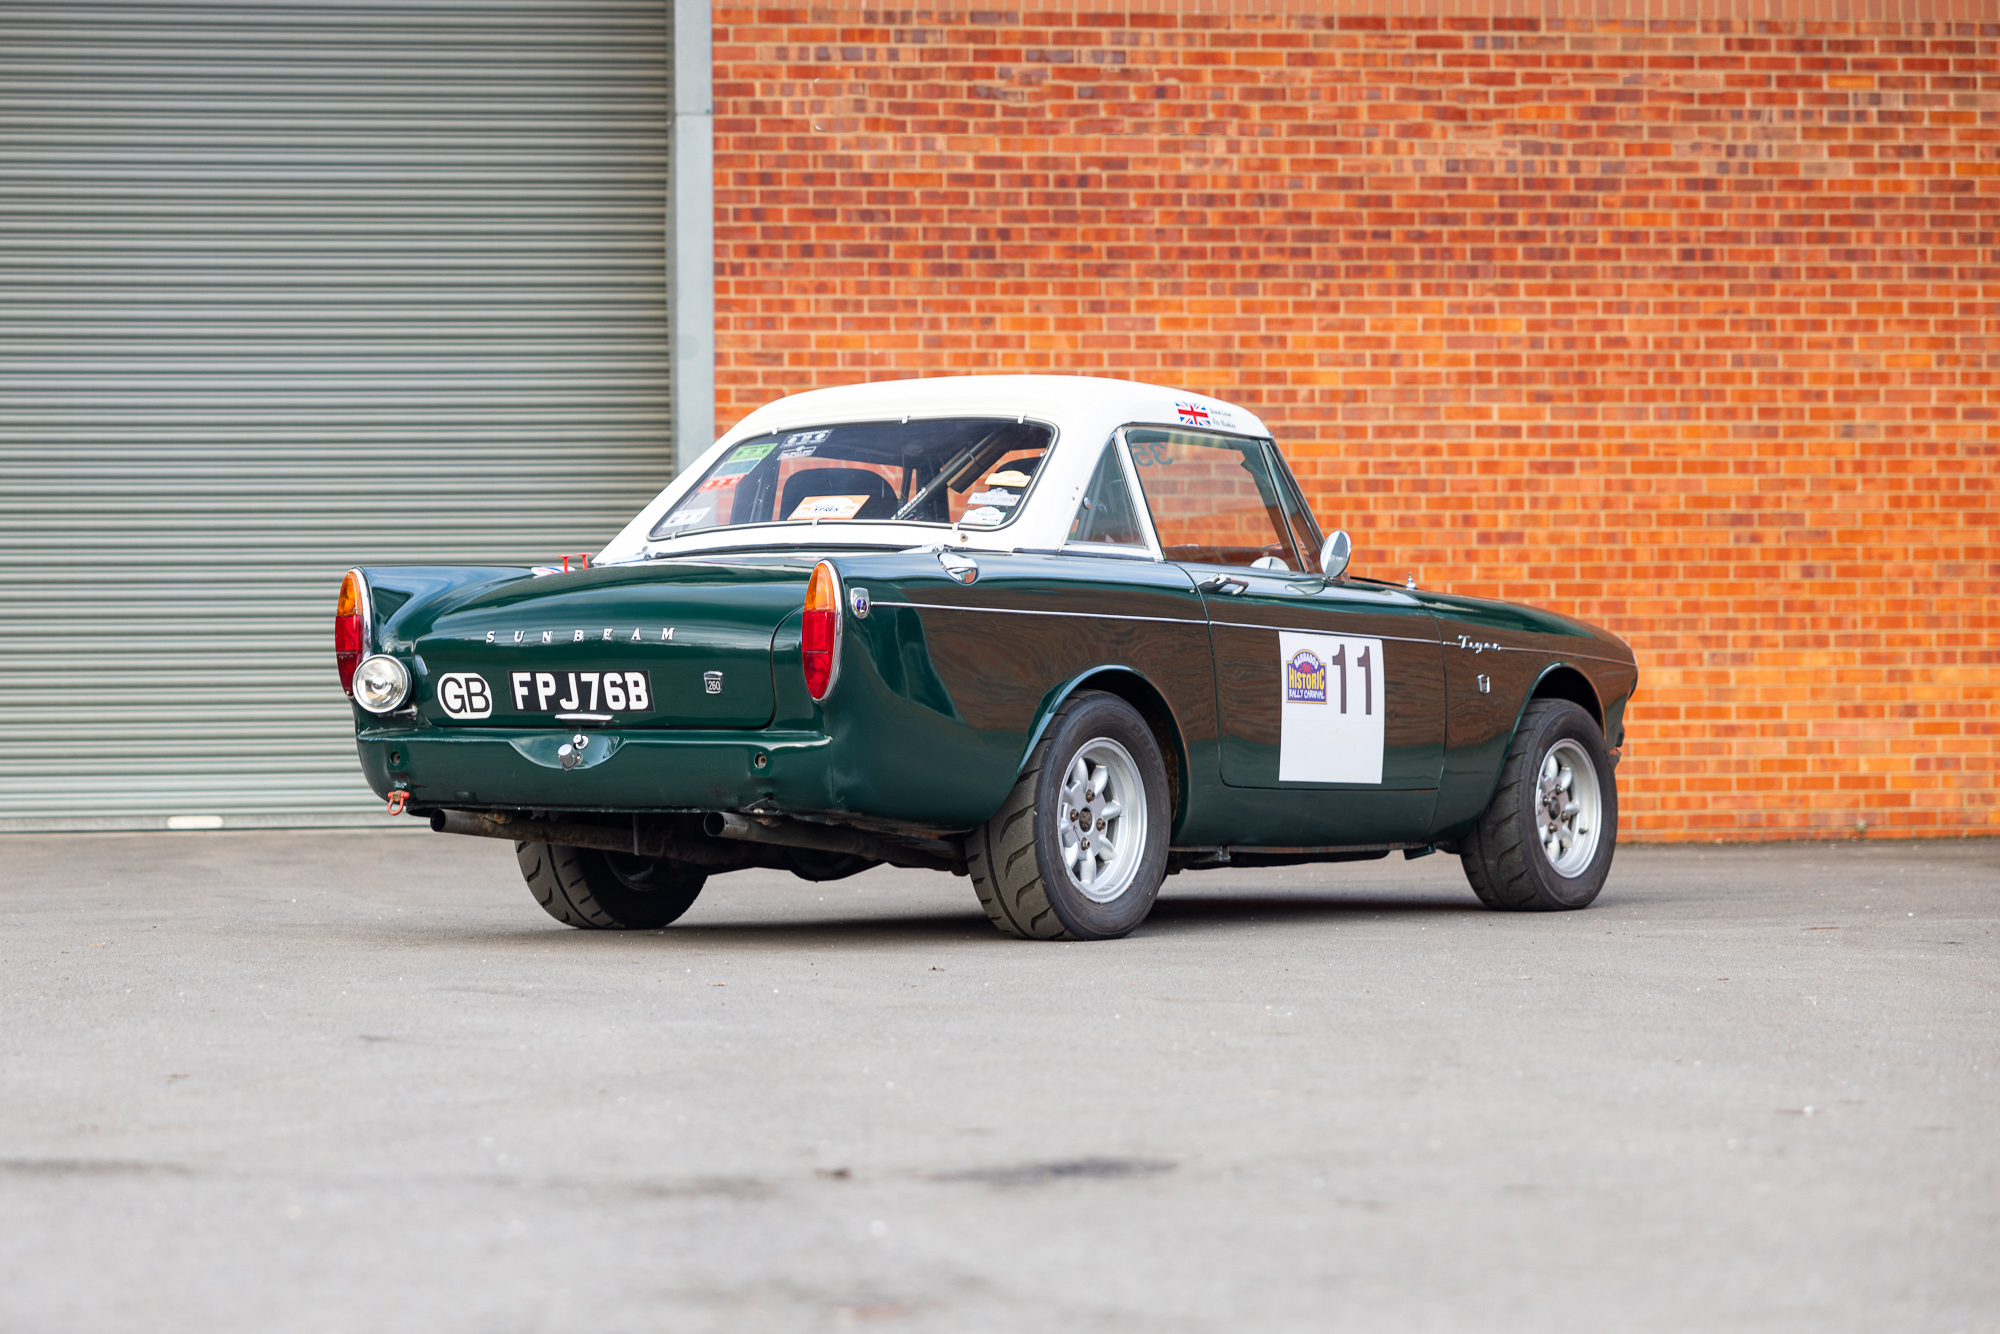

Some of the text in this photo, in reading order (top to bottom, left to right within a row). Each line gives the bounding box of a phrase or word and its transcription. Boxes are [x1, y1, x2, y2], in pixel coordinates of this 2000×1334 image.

[485, 627, 676, 644] SUNBEAM
[1293, 651, 1319, 670] BARBADOS
[708, 680, 721, 692] 260
[1288, 665, 1325, 690] HISTORIC
[1332, 644, 1371, 715] 11
[440, 676, 491, 714] GB
[512, 672, 649, 711] FPJ76B
[1288, 688, 1325, 700] RALLY CARNIVAL
